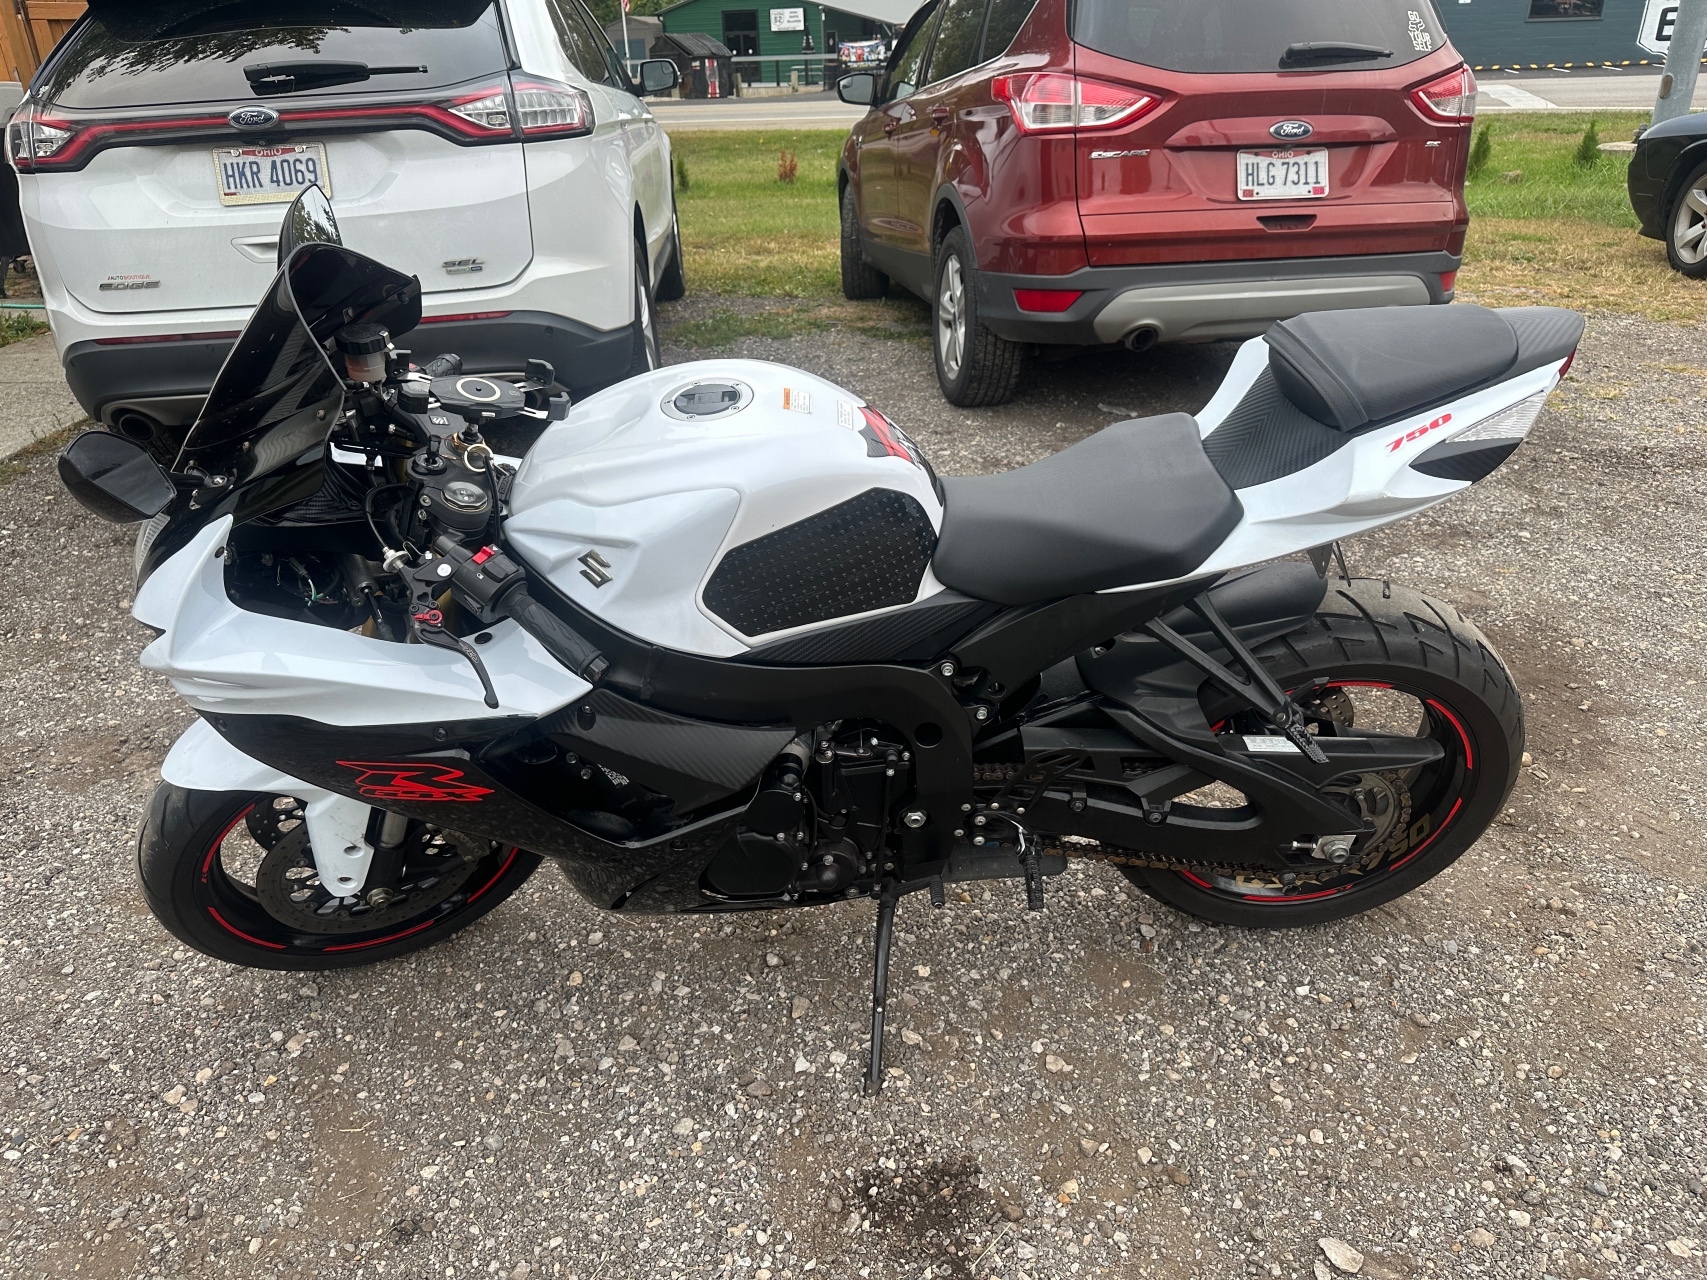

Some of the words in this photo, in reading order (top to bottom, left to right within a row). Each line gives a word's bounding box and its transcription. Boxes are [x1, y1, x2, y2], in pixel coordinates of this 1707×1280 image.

[1407, 10, 1420, 21] GO
[1407, 31, 1430, 42] YOUR
[1412, 40, 1431, 51] SELF
[240, 111, 265, 124] Ford
[1280, 123, 1305, 136] Ford
[255, 147, 282, 156] OHIO
[1089, 149, 1150, 159] ESCAPE
[1271, 150, 1294, 159] OHIO
[223, 161, 263, 189] HKR
[270, 158, 318, 186] 4069
[1245, 162, 1275, 187] HLG
[1281, 160, 1321, 186] 7311
[441, 258, 486, 268] SEL
[98, 280, 161, 291] EDGE
[1385, 413, 1452, 453] 750
